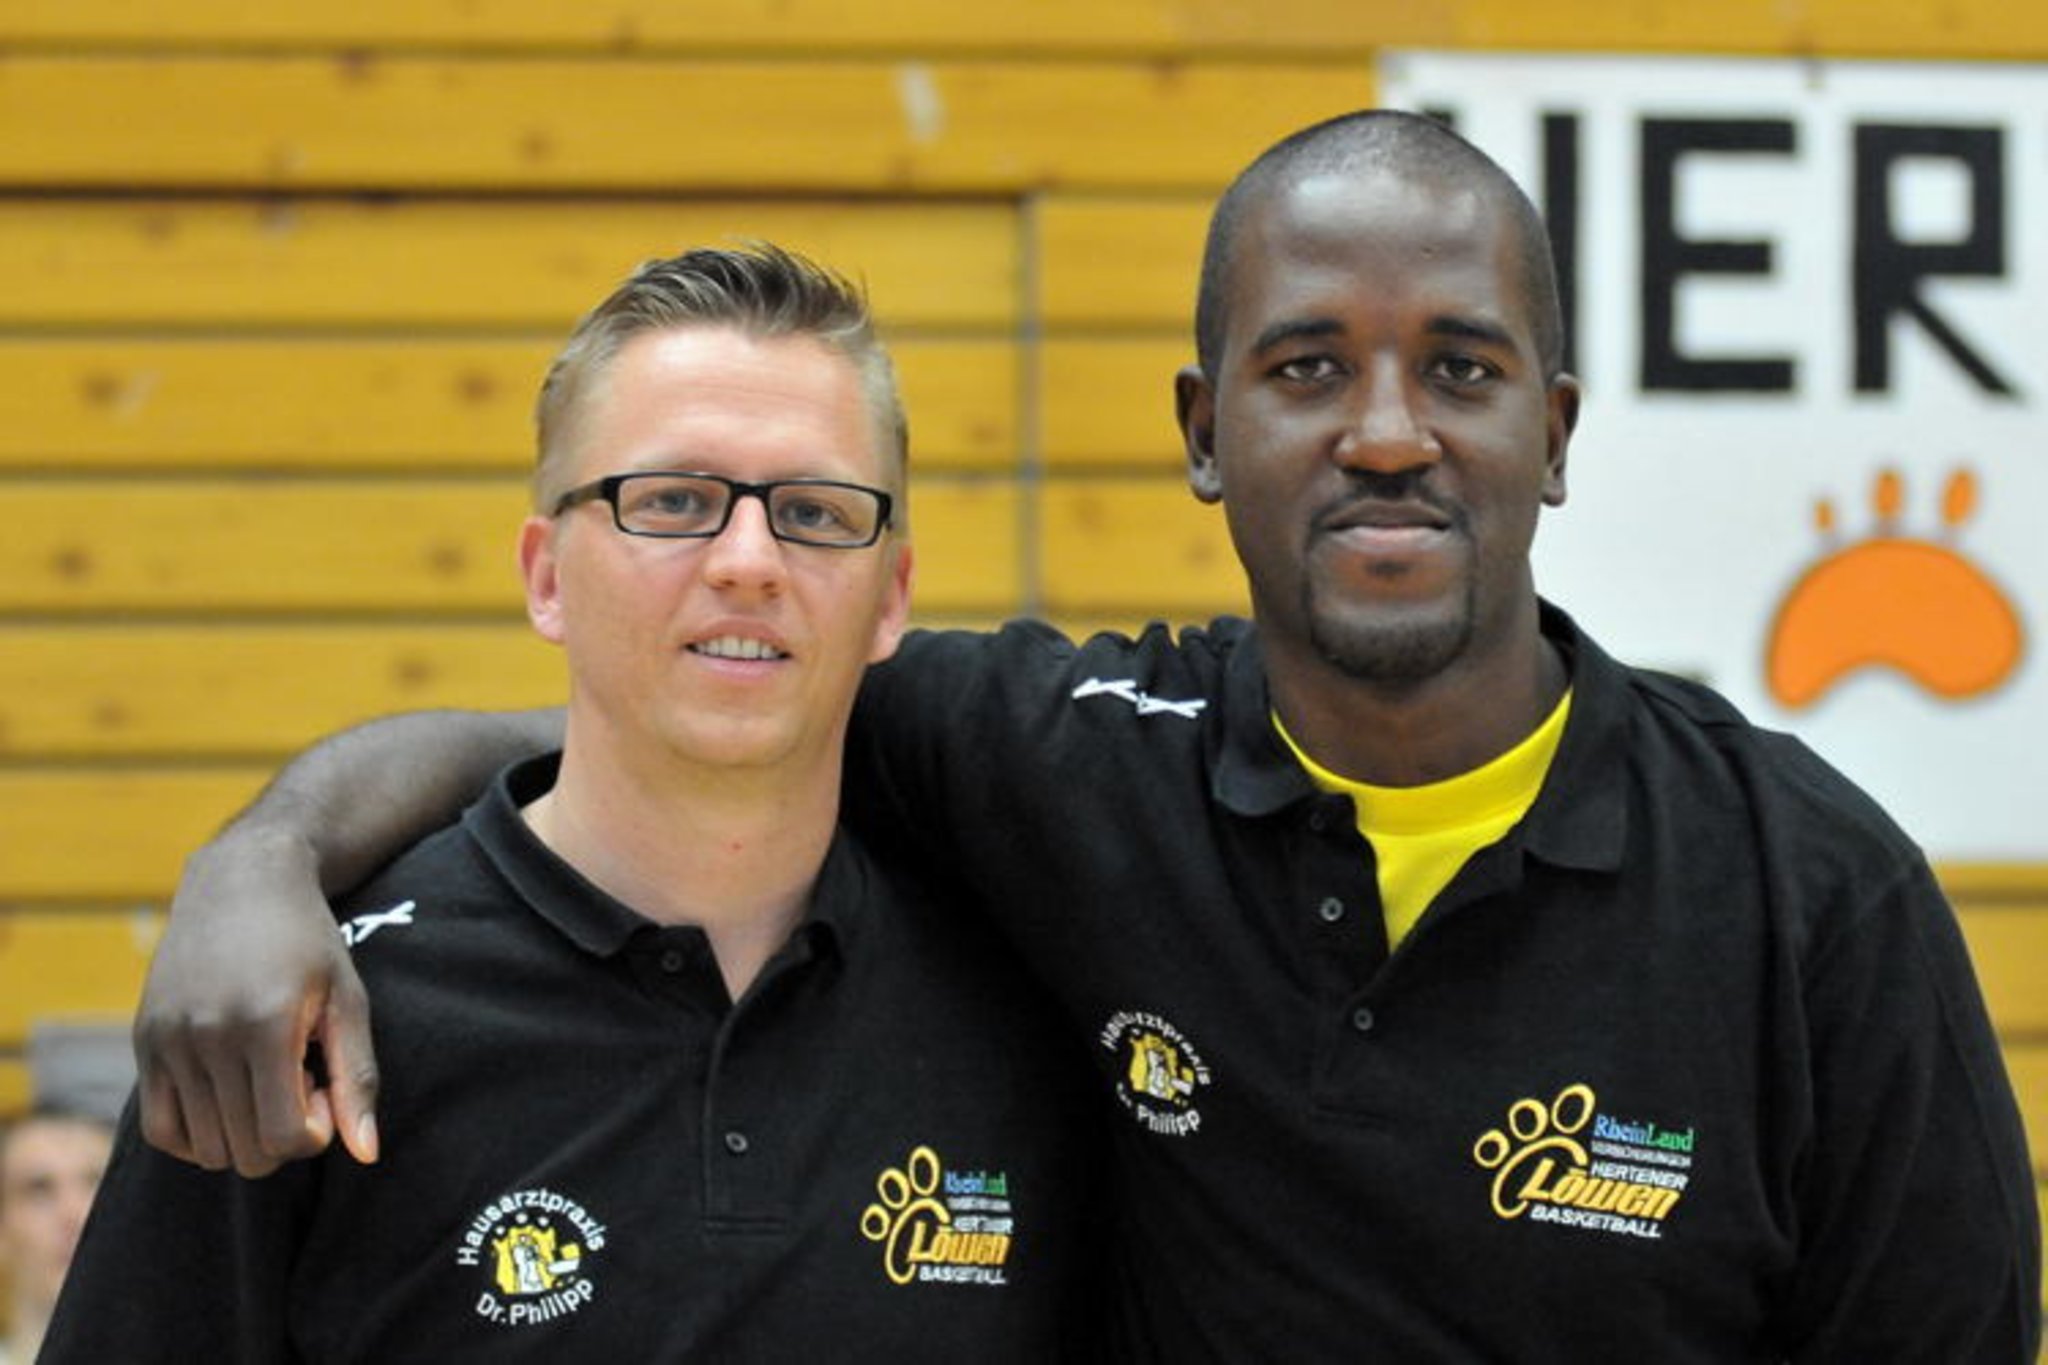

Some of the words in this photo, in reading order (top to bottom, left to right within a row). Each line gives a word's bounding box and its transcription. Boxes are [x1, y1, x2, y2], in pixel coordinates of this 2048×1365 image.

[1591, 1161, 1688, 1190] HERTENER
[457, 1188, 606, 1265] Hausarztpraxis
[1530, 1204, 1661, 1238] BASKETBALL
